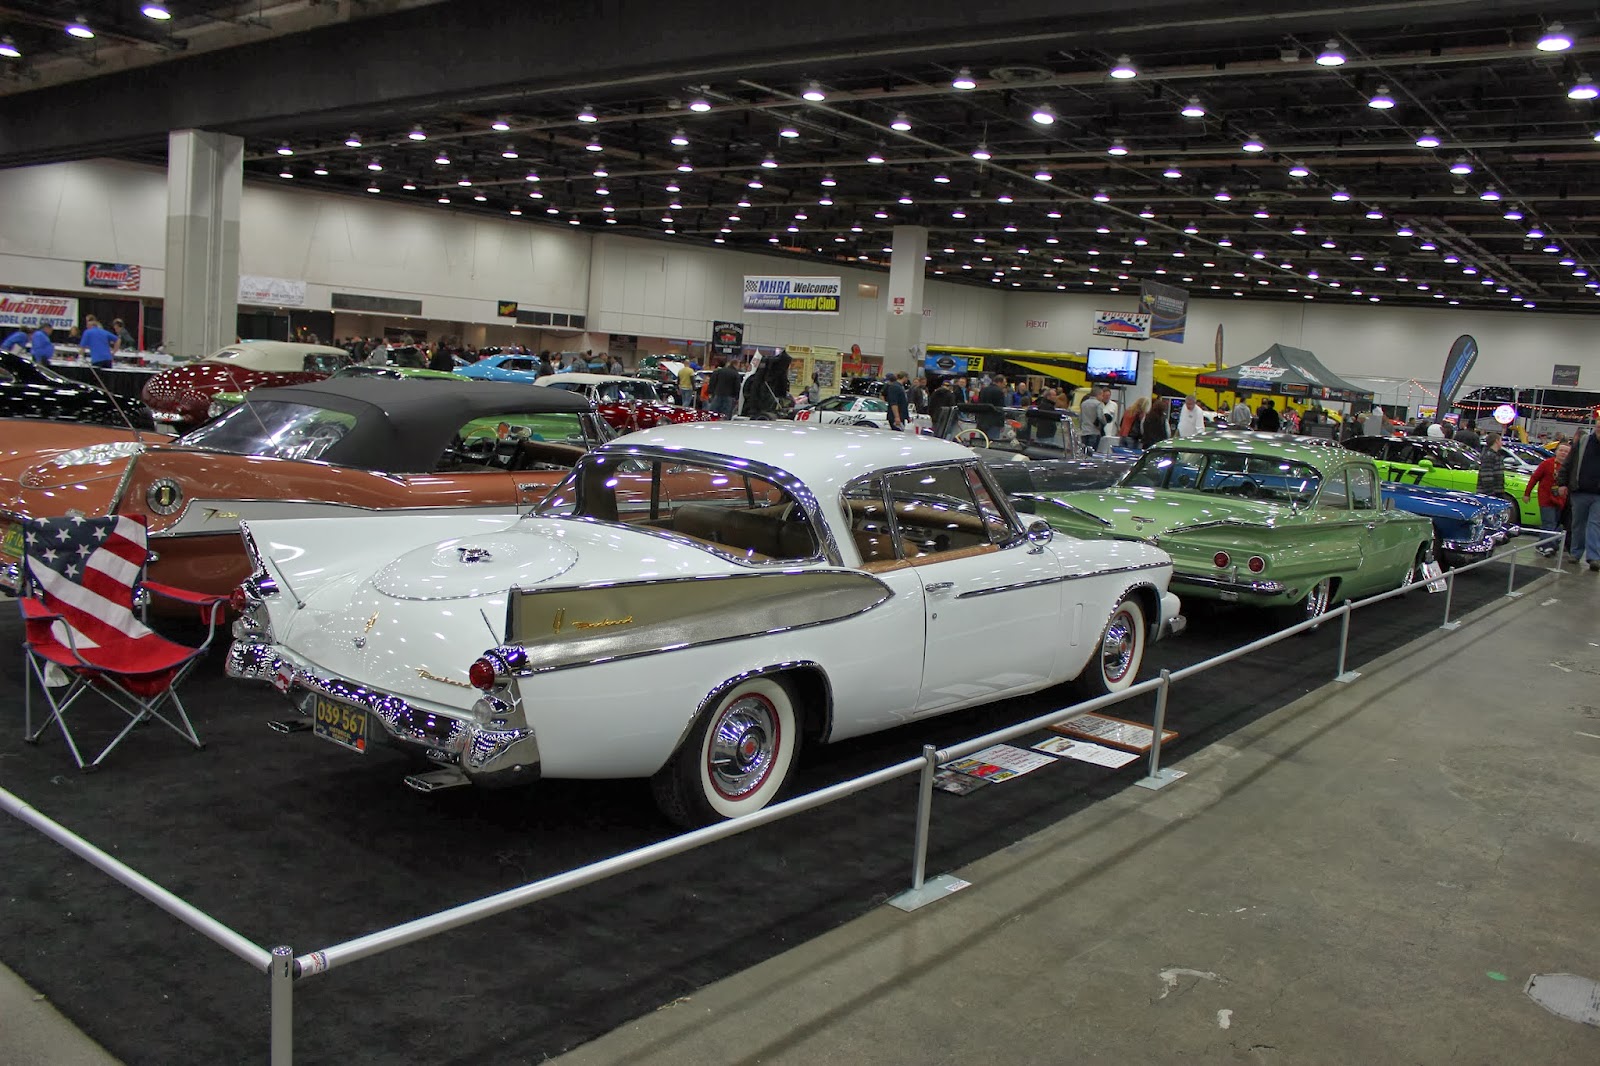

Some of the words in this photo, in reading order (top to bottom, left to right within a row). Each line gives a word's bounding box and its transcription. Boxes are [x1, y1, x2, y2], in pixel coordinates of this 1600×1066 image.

[758, 280, 790, 293] MHRA
[793, 282, 838, 293] Welcomes
[783, 296, 817, 310] Featured
[817, 297, 837, 311] Club
[922, 309, 931, 317] XIT
[0, 315, 19, 324] ODEL
[21, 317, 37, 325] CAR
[39, 317, 73, 327] CONTEST
[318, 701, 340, 726] 039
[342, 708, 366, 736] 567
